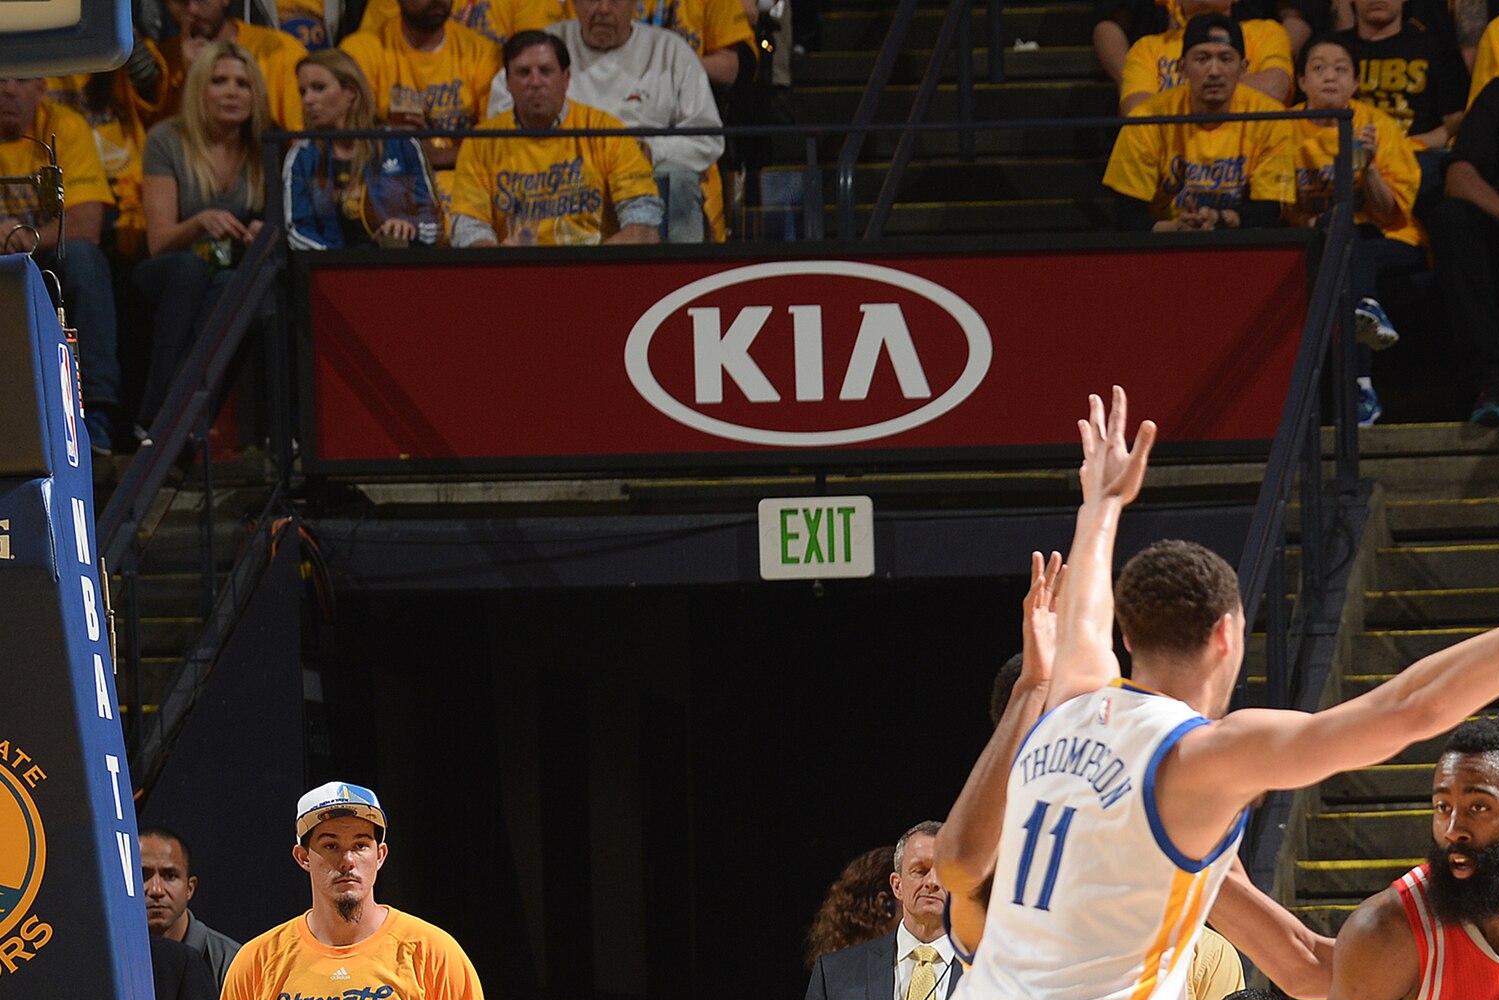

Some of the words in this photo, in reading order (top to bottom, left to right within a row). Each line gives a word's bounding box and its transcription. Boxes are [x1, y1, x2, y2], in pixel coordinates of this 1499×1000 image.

[1359, 58, 1429, 93] UBS
[687, 303, 932, 404] KIA
[780, 506, 856, 564] EXIT
[71, 497, 113, 721] NBA
[104, 754, 135, 897] TV
[1019, 736, 1133, 811] THOMPSON
[1011, 800, 1077, 913] 11
[0, 914, 54, 978] RS
